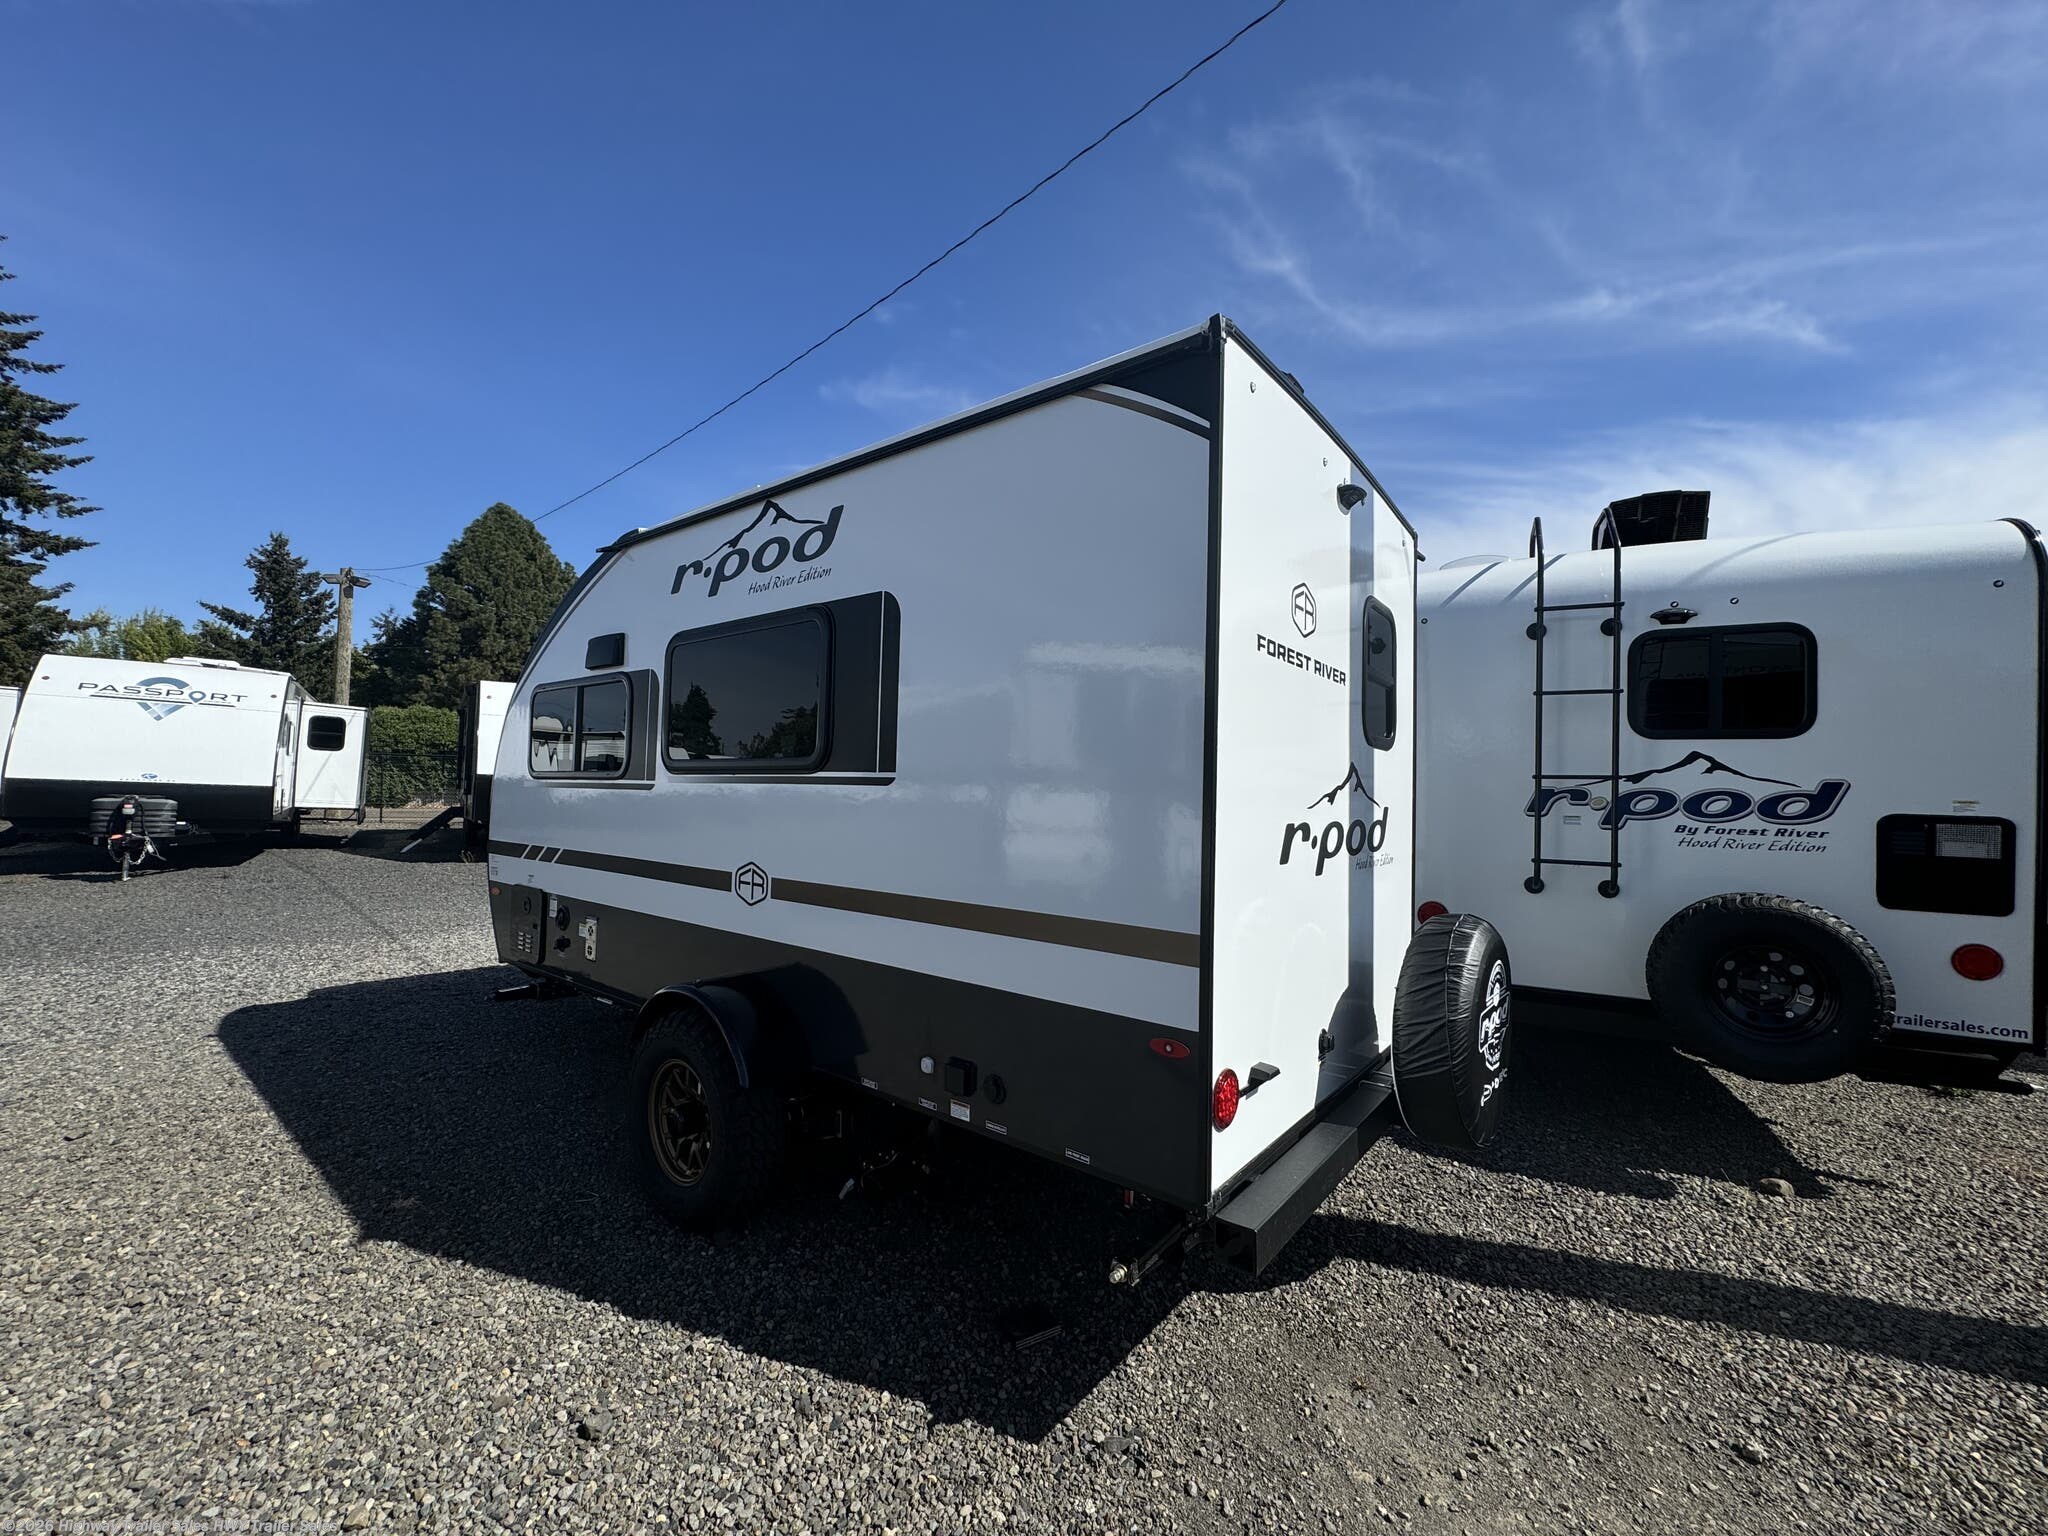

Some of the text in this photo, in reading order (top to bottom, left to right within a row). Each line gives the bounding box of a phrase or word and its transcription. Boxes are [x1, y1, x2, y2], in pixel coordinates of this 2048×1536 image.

[748, 565, 832, 595] Hood River Edition
[1256, 633, 1347, 686] FOREST RIVER
[78, 682, 248, 703] PASSPORT
[1674, 824, 1830, 839] By Forest River
[1678, 836, 1828, 853] Hood River Edition
